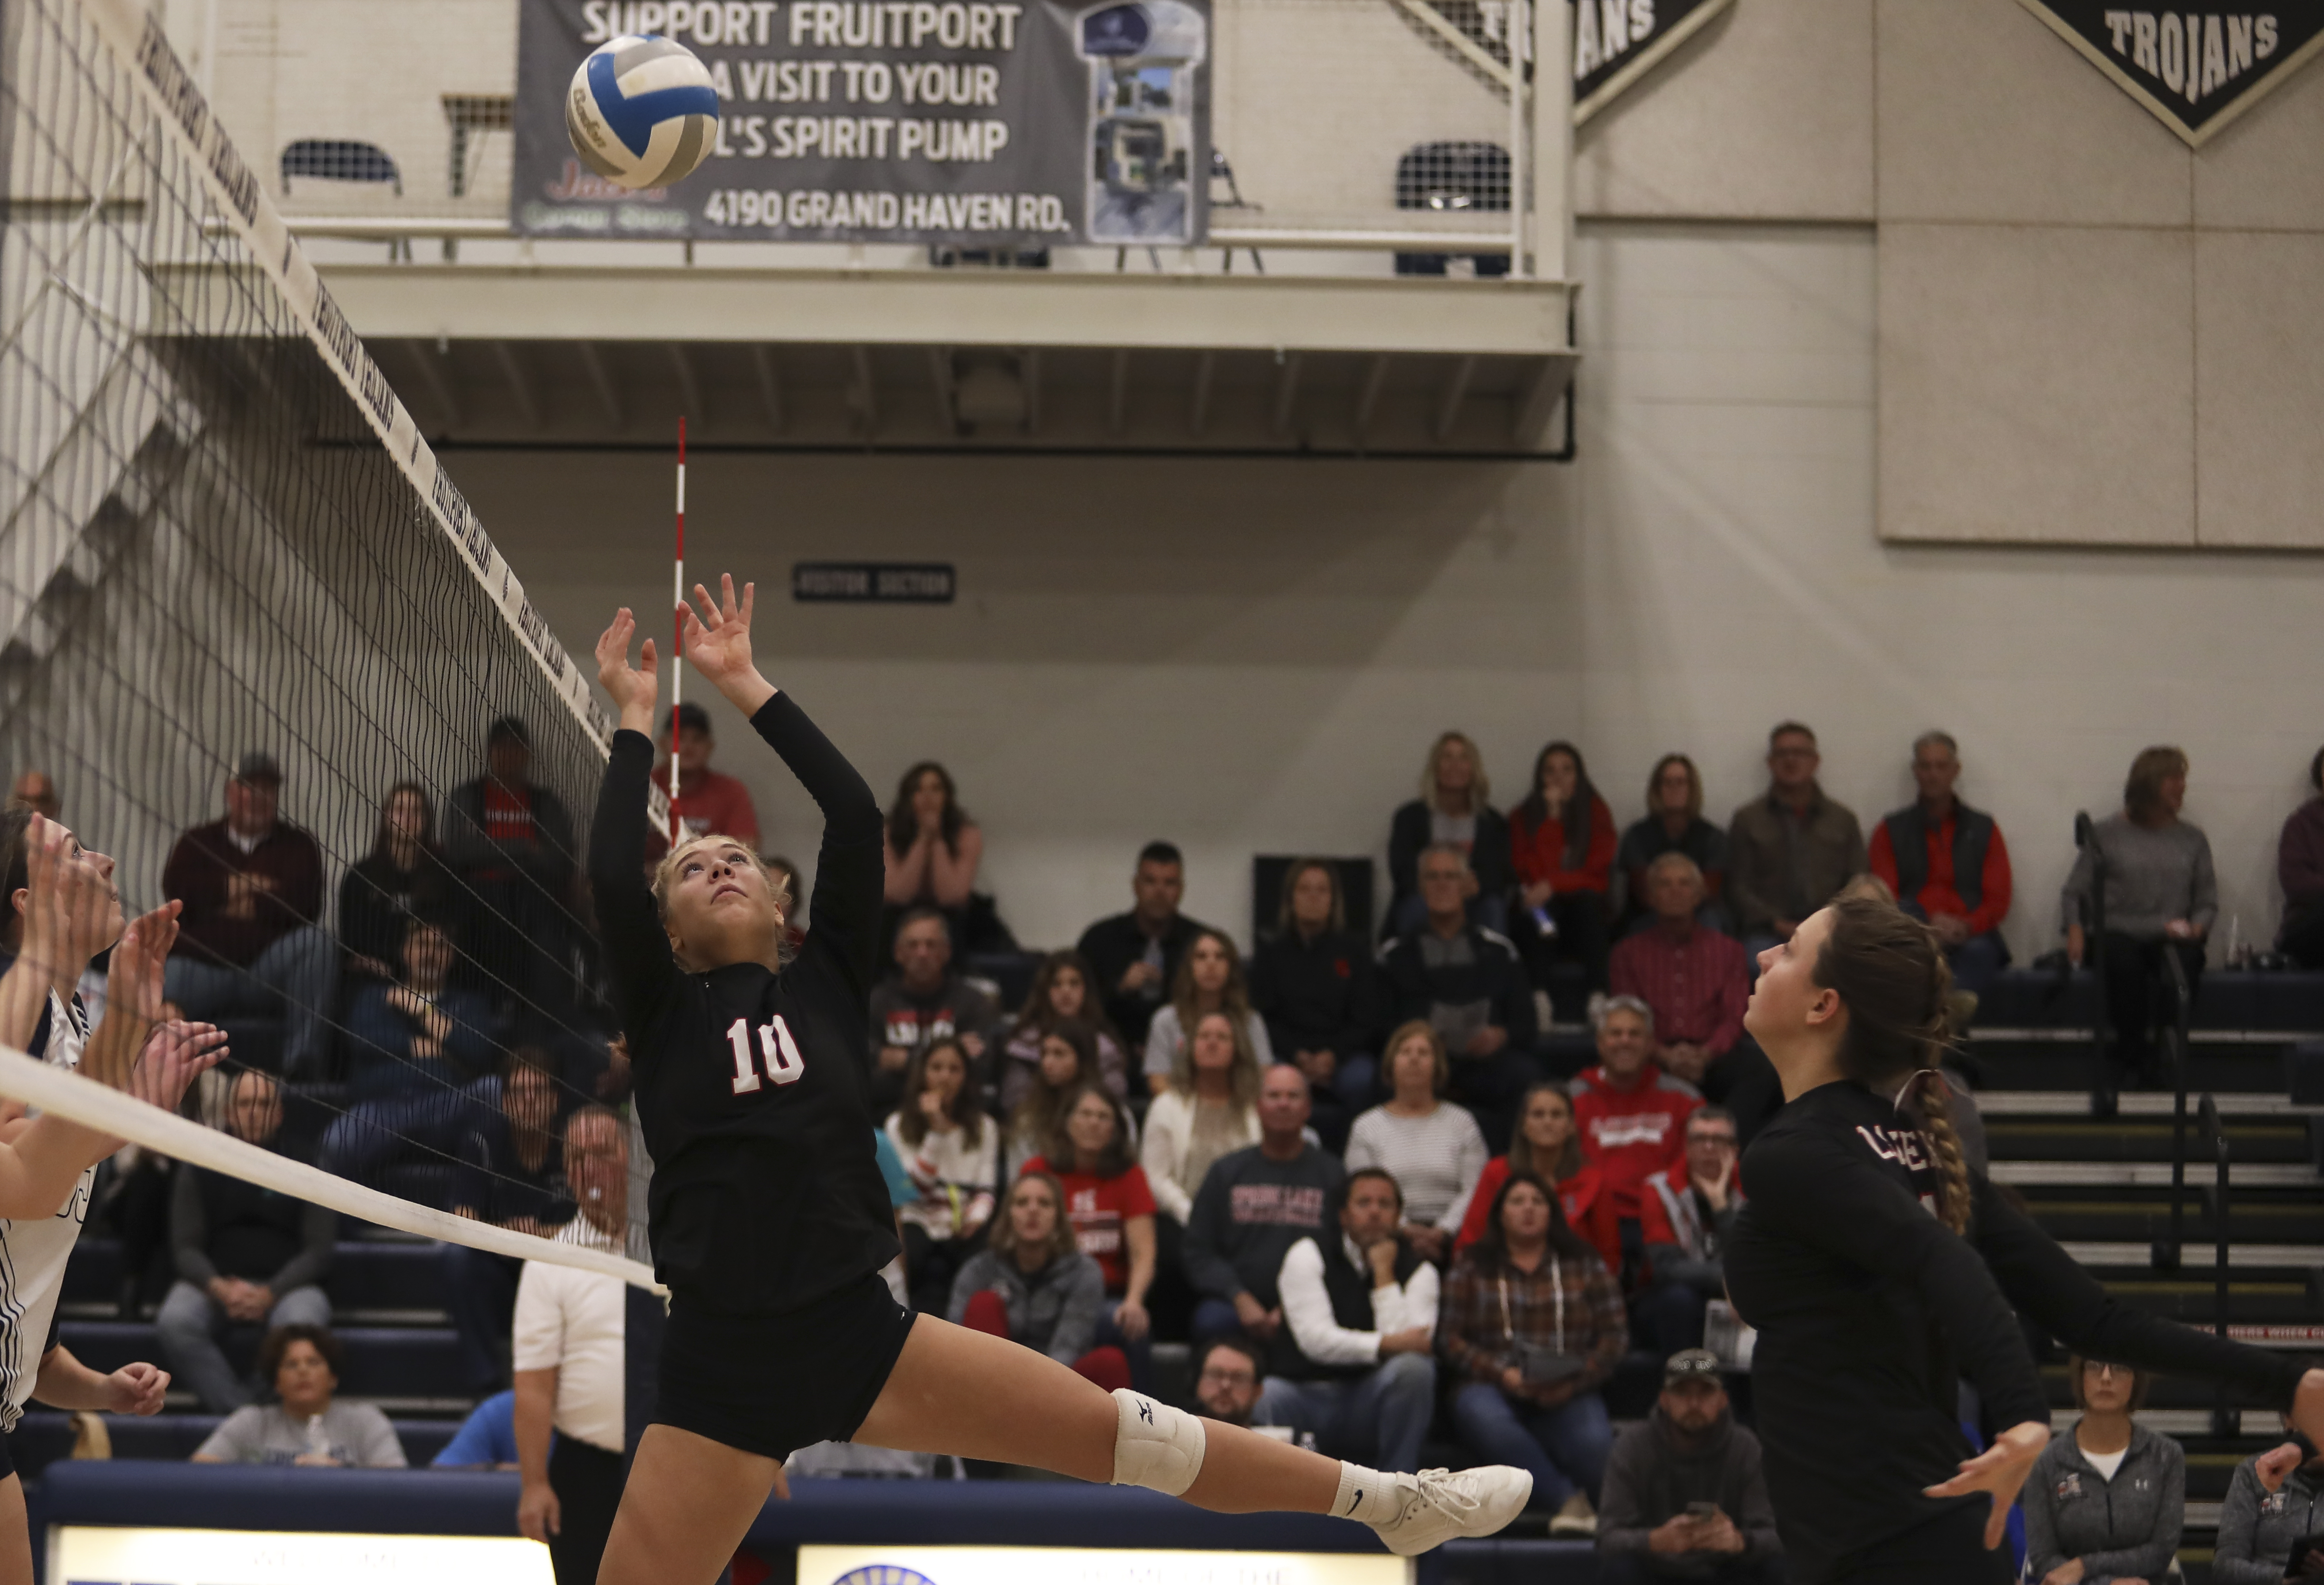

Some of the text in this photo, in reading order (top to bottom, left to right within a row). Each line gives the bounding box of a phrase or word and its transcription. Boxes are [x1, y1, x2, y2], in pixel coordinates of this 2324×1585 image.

[581, 1, 1023, 49] SUPPORT FRUITPORT
[2104, 10, 2279, 106] TROJANS
[738, 59, 836, 103] VISIT
[840, 61, 893, 104] TO
[895, 62, 1000, 106] YOUR
[771, 115, 895, 159] SPIRIT
[897, 118, 1010, 163] PUMP
[703, 189, 785, 228] 4190
[786, 191, 902, 230] GRAND
[903, 192, 1014, 231] HAVEN
[1016, 194, 1072, 232] RD.
[726, 1013, 807, 1096] 10
